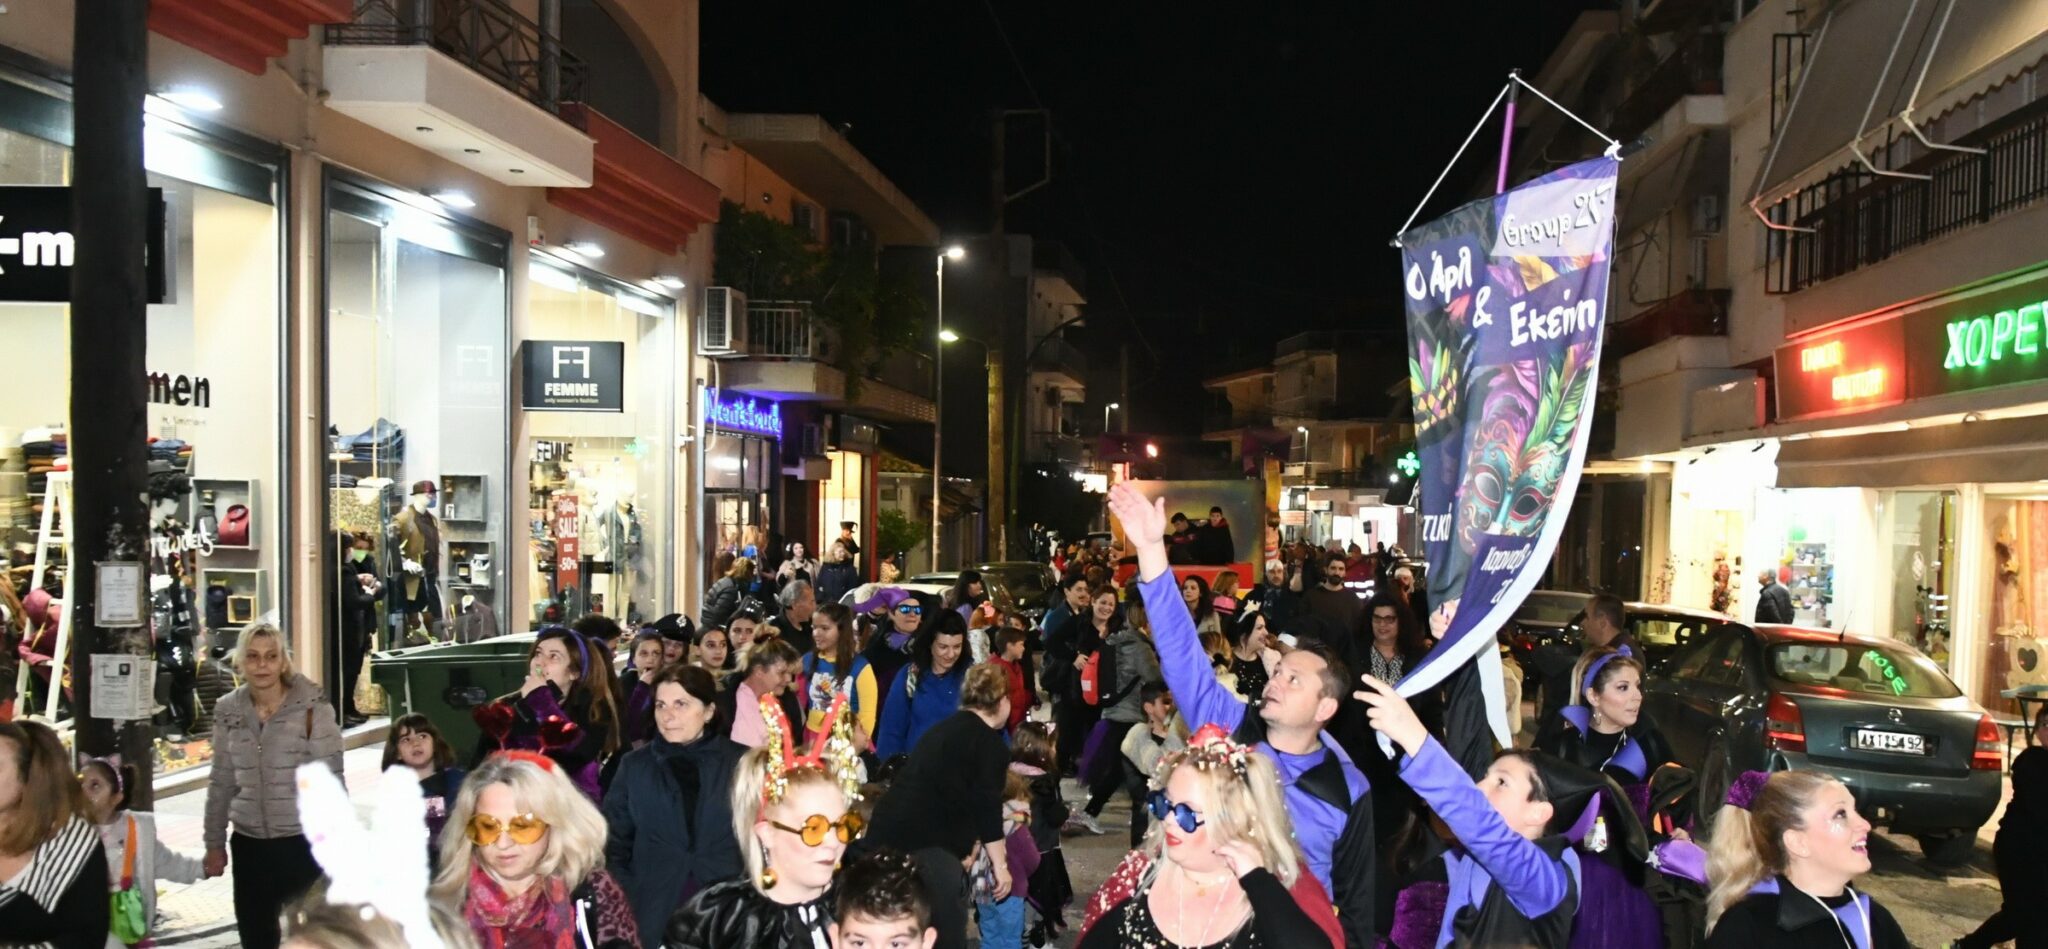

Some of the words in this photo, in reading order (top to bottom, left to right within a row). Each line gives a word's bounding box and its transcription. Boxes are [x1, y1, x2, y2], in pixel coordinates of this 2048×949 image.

[1503, 213, 1571, 247] Group
[1473, 286, 1494, 328] &
[544, 382, 599, 396] FEMME
[559, 517, 578, 538] SALE
[559, 556, 578, 571] -50%
